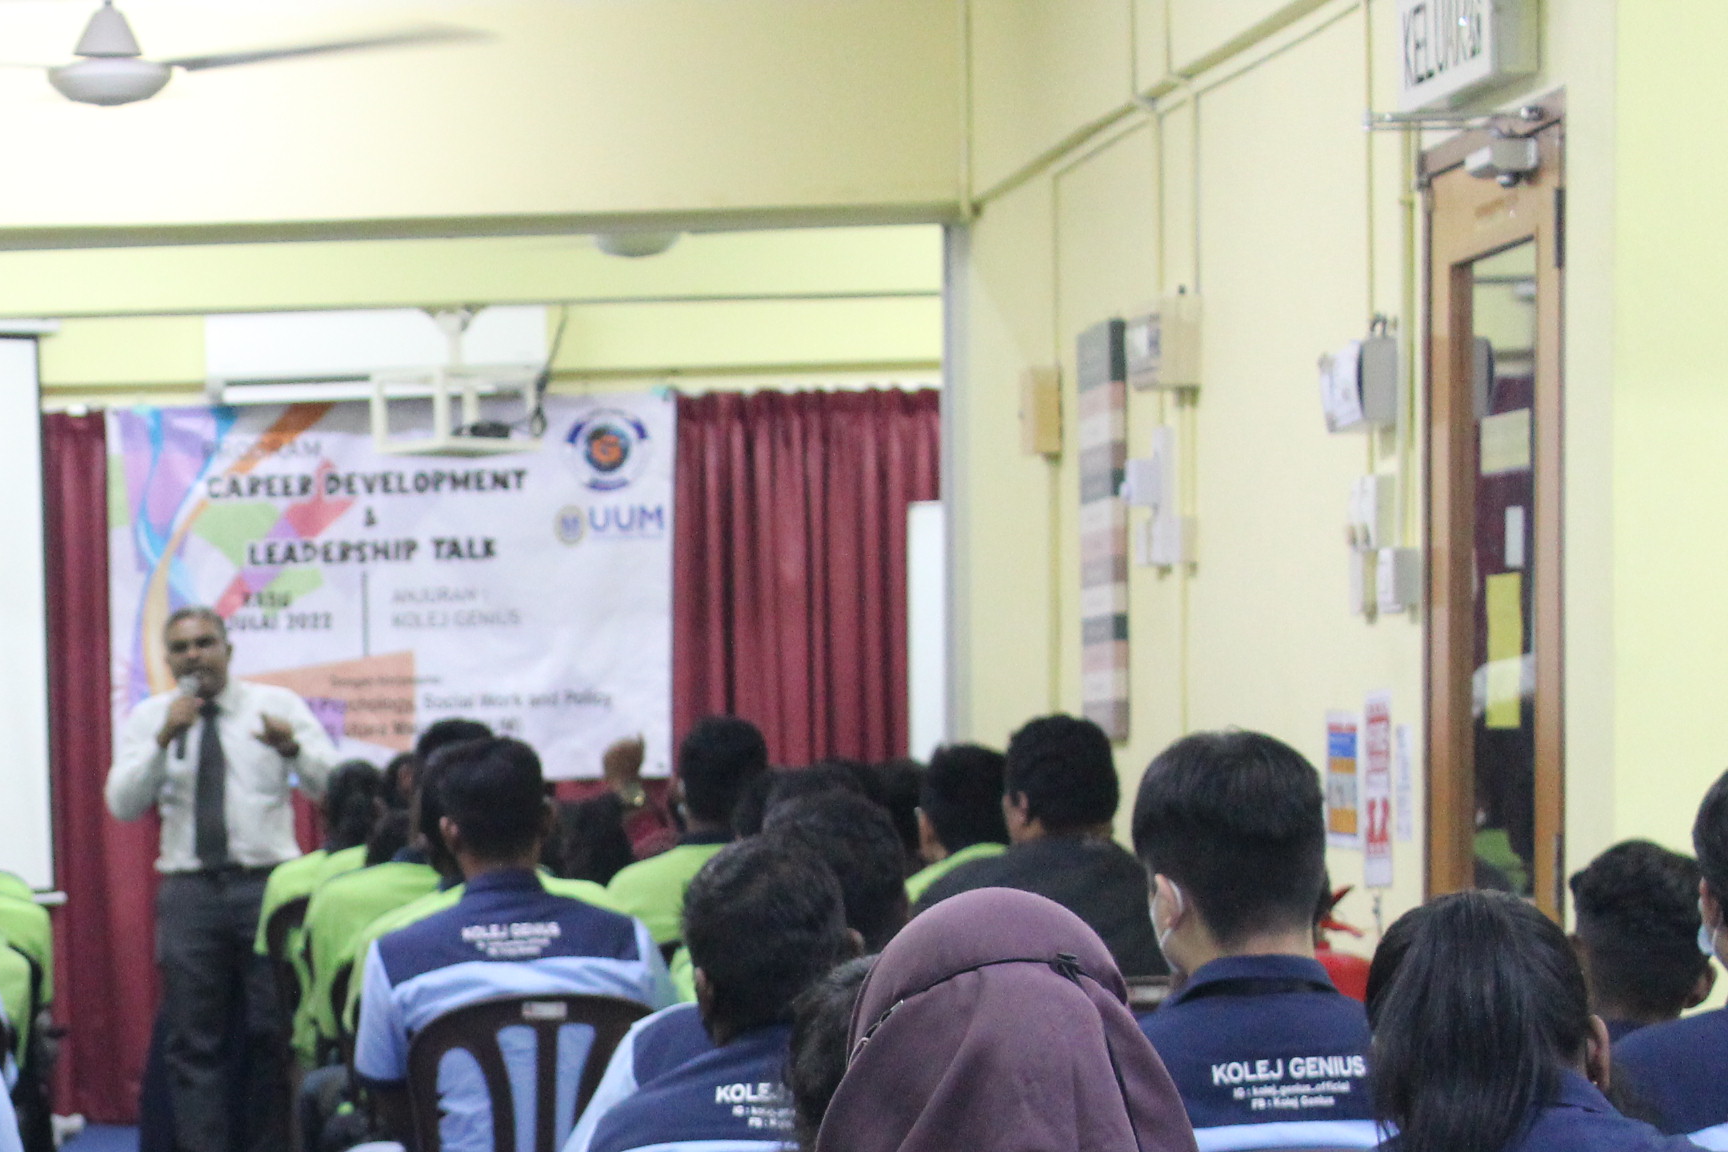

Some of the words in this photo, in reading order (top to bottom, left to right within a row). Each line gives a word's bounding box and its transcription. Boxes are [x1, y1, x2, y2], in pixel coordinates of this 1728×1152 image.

[206, 474, 314, 499] CAREER
[323, 468, 528, 496] DEVELOPMENT
[588, 504, 665, 532] UUM
[247, 539, 419, 566] LEADERSHIP
[431, 537, 497, 560] TALK
[1211, 1058, 1285, 1086] KOLEJ
[1288, 1055, 1367, 1079] GENIUS
[715, 1082, 785, 1104] KOLE
